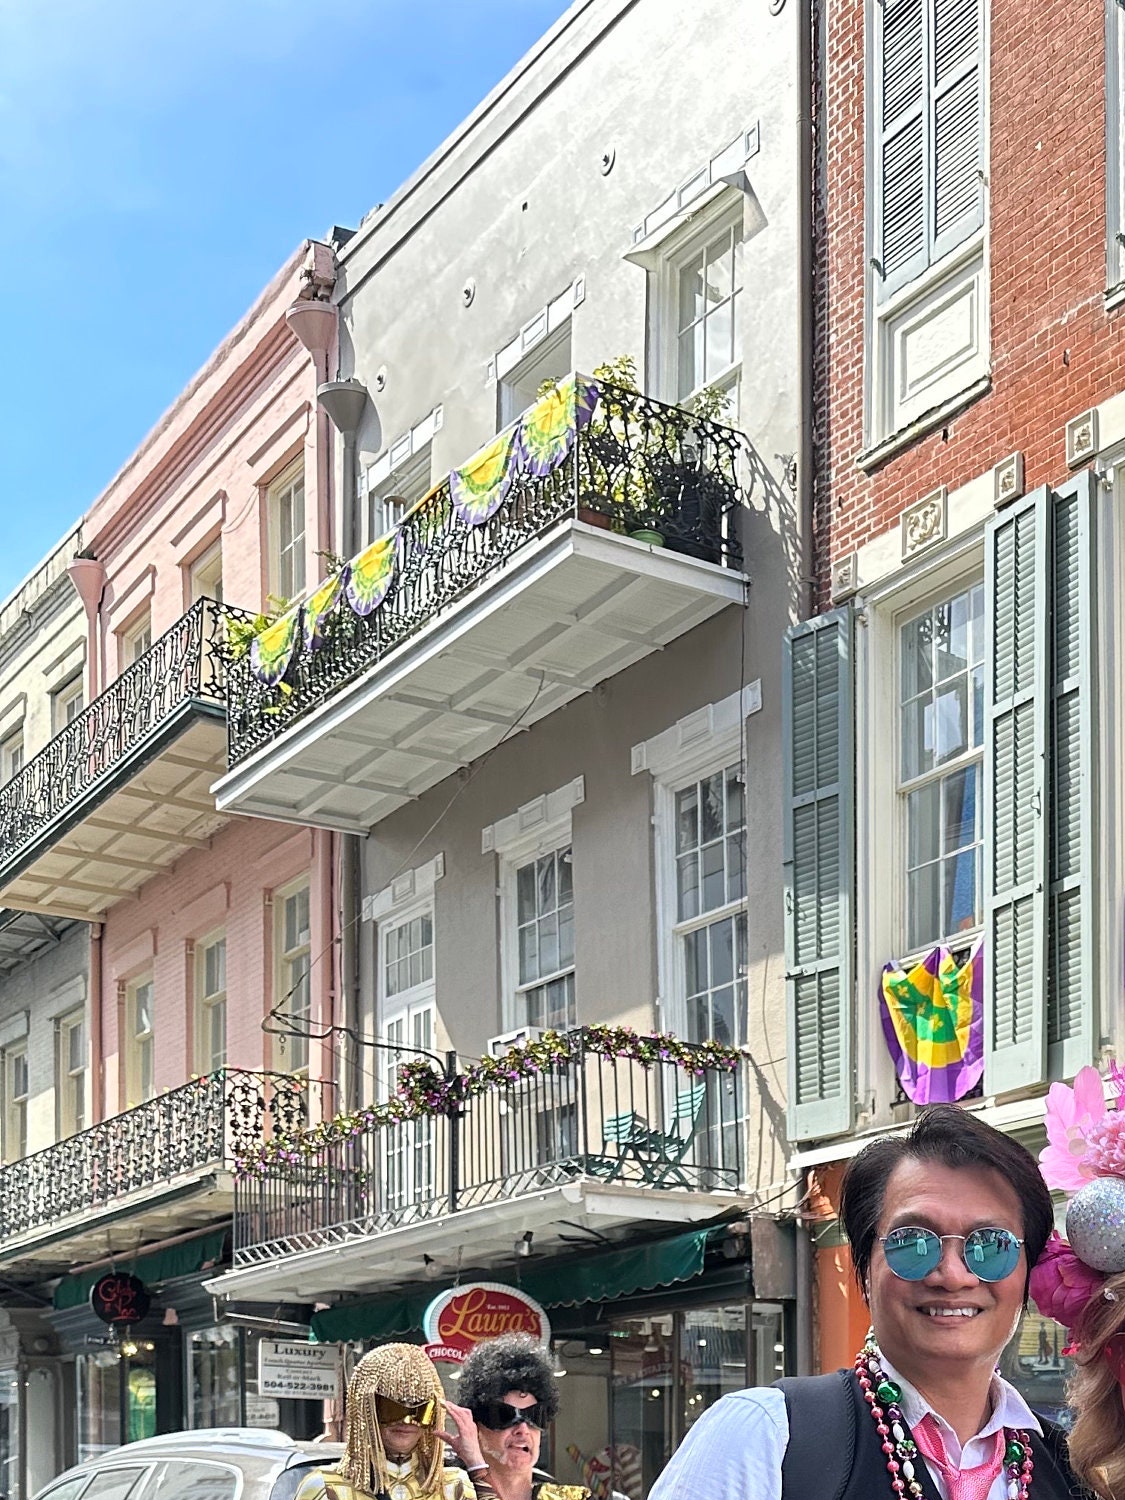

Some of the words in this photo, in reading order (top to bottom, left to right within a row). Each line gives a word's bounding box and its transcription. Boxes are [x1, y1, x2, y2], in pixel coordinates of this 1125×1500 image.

[440, 1289, 539, 1342] Laura's
[274, 1344, 326, 1359] Luxury
[430, 1347, 468, 1361] CHOCOL
[264, 1381, 335, 1392] 504-522-3981
